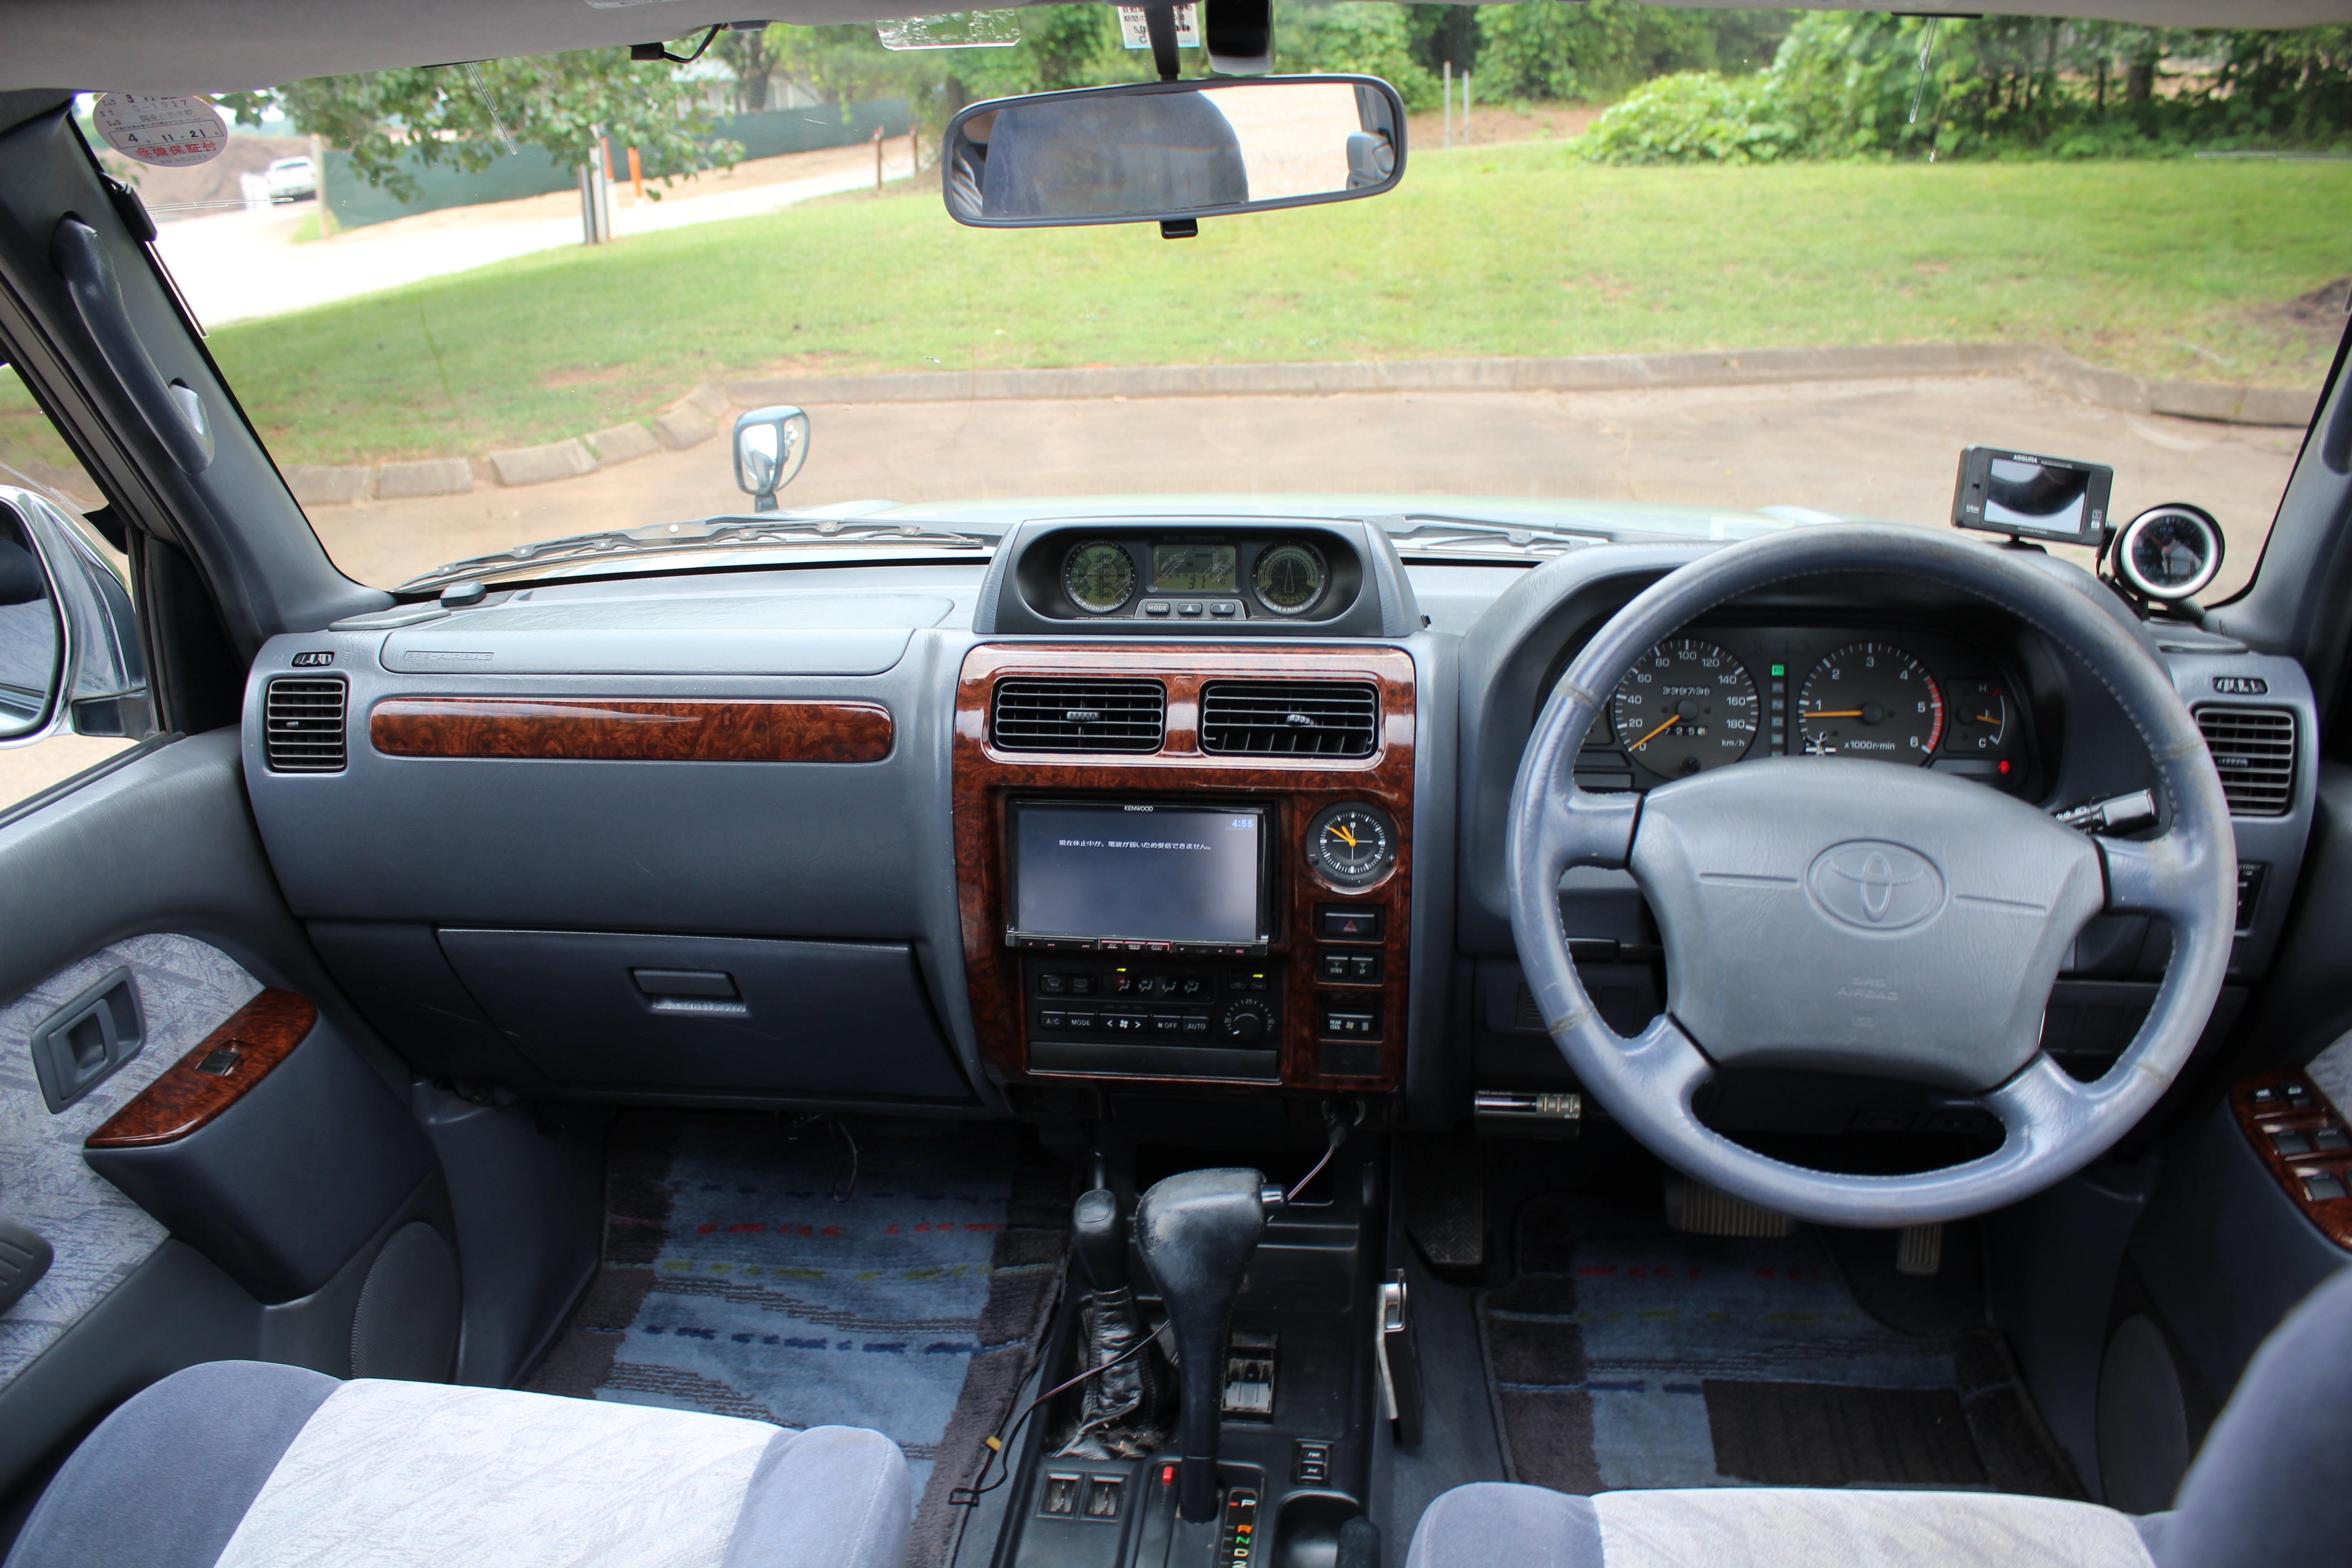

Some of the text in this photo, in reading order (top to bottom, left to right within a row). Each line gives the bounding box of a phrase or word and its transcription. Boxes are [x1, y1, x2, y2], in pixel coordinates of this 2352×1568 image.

[126, 94, 134, 103] 3
[128, 133, 138, 142] 4
[189, 128, 206, 138] 21
[1081, 540, 1119, 549] CLINOMETER
[1082, 602, 1119, 610] PITCH/ROLL
[405, 652, 493, 661] SRS-AIRBAG
[1677, 651, 1696, 660] 100
[1656, 658, 1670, 667] 80
[1701, 658, 1720, 667] 120
[1866, 656, 1874, 667] 3
[1637, 674, 1651, 683] 60
[1832, 668, 1840, 680] 2
[1900, 670, 1908, 681] 4
[1718, 675, 1737, 685] 140
[1979, 684, 1986, 693] H
[1628, 695, 1642, 704] 40
[1727, 696, 1746, 706] 160
[1816, 700, 1822, 711] 1
[1917, 701, 1926, 713] 5
[1629, 718, 1643, 727] 20
[1726, 720, 1745, 729] 180
[1721, 739, 1744, 747] km/h
[1910, 736, 1919, 747] 6
[1638, 743, 1646, 751] 0
[1232, 819, 1253, 828] 4:55
[1237, 1524, 1254, 1534] R
[1235, 1536, 1251, 1544] N
[1234, 1548, 1249, 1558] D
